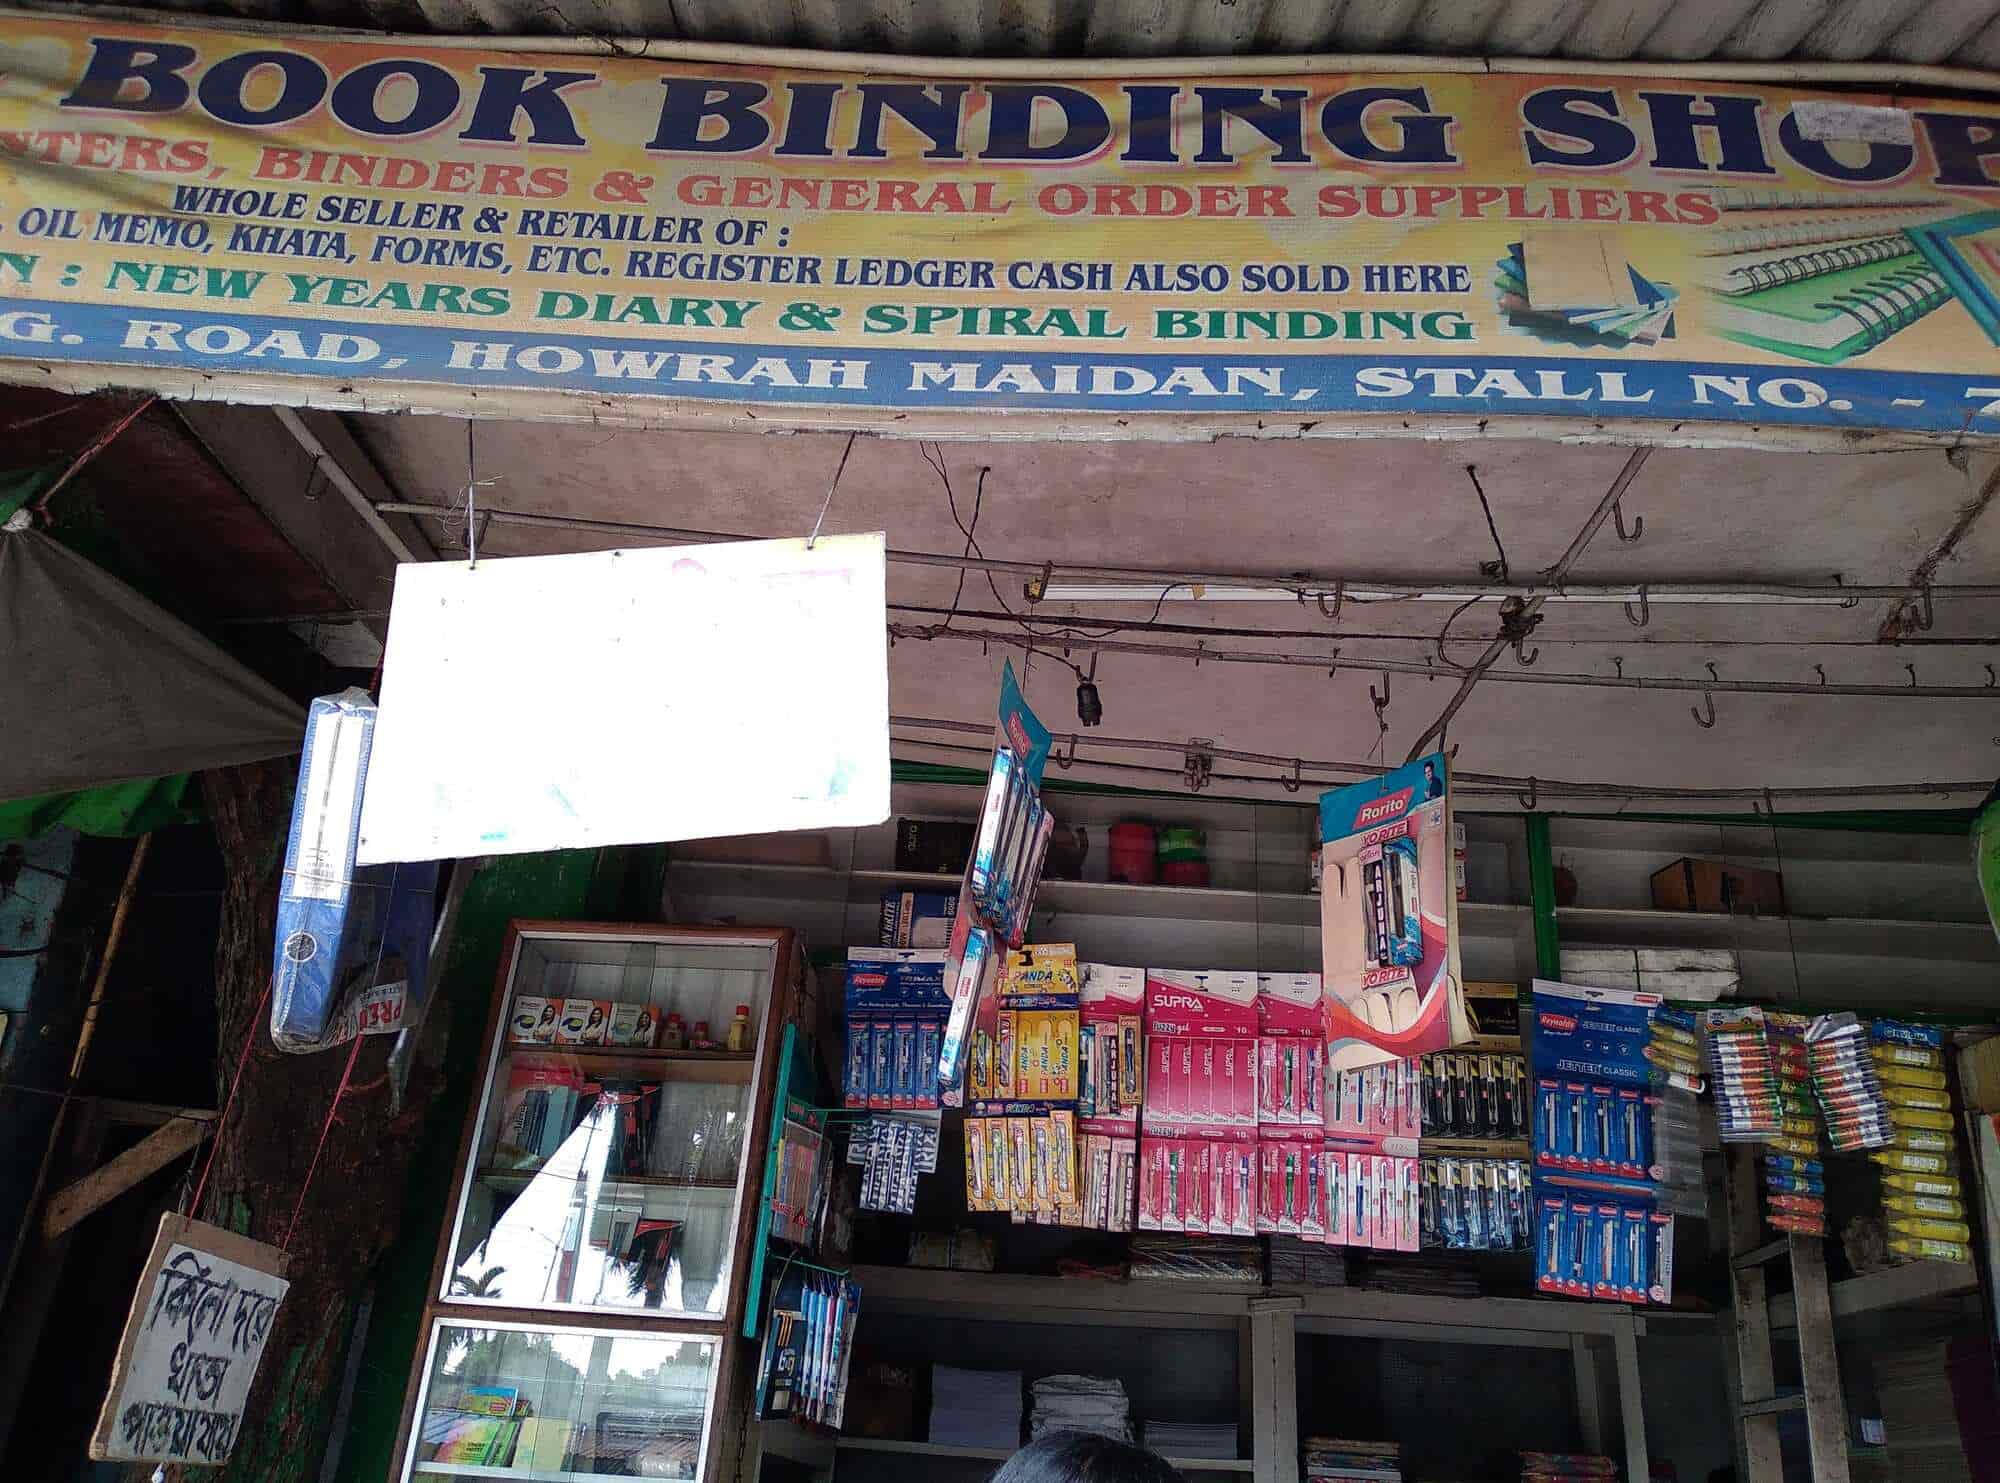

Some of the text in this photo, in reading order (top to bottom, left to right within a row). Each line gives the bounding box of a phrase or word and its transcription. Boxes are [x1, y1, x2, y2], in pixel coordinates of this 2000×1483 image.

[60, 37, 597, 146] BOOK
[646, 78, 1458, 165] BINDING
[173, 185, 306, 221] WHOLE
[316, 194, 463, 232] SELLER
[472, 206, 509, 235] &
[518, 209, 703, 244] RETAILER
[254, 147, 569, 199] BINDERS
[592, 170, 654, 203] &
[677, 175, 1012, 214] GENERAL
[1037, 184, 1296, 218] ORDER
[1318, 185, 1721, 225] SUPPLIERS
[18, 207, 1472, 293] OIL MEMO, KHATA, FORMS, ETC. REGISTER LEDGER CASH ALSO SOLD HERE
[105, 261, 269, 299] NEW
[287, 273, 511, 317] YEARS
[537, 290, 761, 330] DIARY
[778, 303, 841, 333] &
[863, 304, 1127, 338] SPIRAL
[1155, 310, 1476, 341] BINDING
[120, 319, 409, 368] ROAD,
[446, 341, 871, 391] HOWRAH
[908, 361, 1318, 402] MAIDAN,
[1355, 367, 1655, 402] STALL
[1688, 374, 1854, 411] NO.
[1361, 799, 1404, 823] Rorito
[1014, 969, 1054, 982] PANDA
[1153, 994, 1204, 1010] SUPRA
[1541, 1015, 1577, 1029] Reynolds
[1603, 1066, 1639, 1078] CLASSIC
